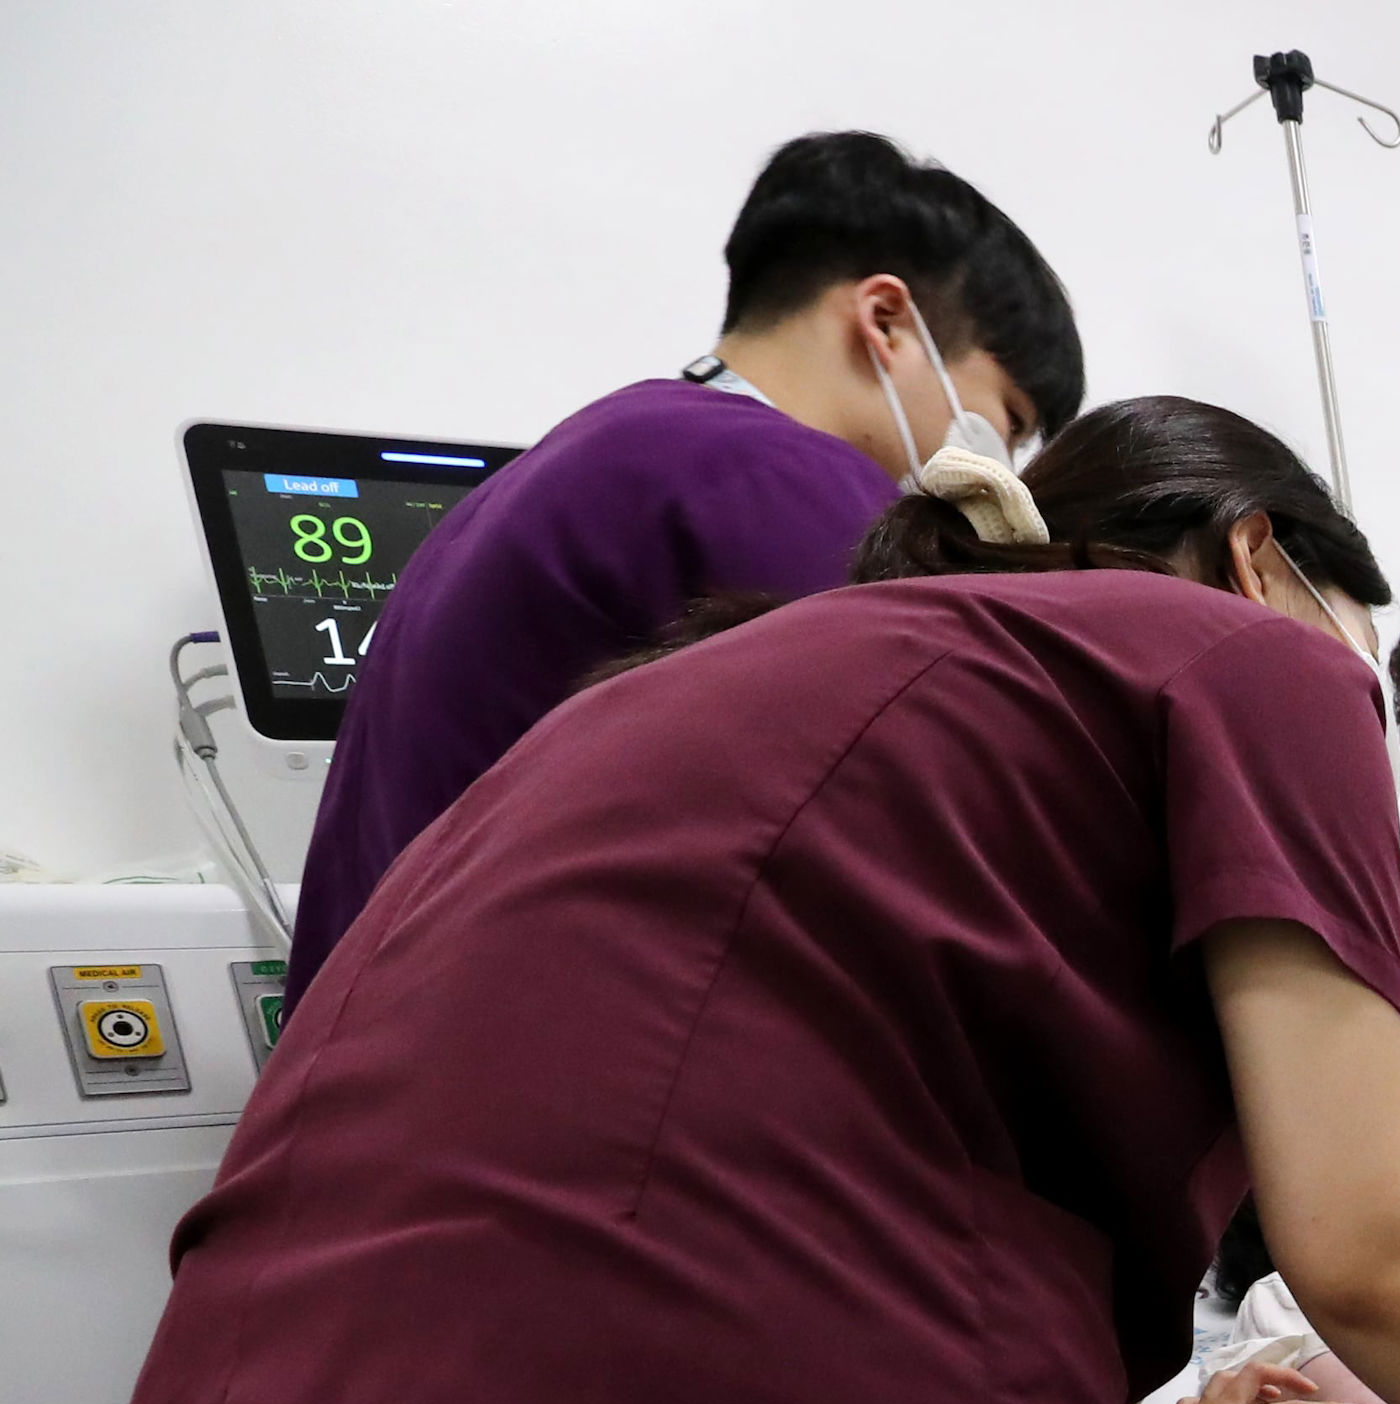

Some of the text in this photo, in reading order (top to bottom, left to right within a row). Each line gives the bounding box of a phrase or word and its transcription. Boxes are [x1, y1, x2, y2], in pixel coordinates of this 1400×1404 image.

[283, 479, 340, 493] Lead off
[289, 514, 373, 565] 89
